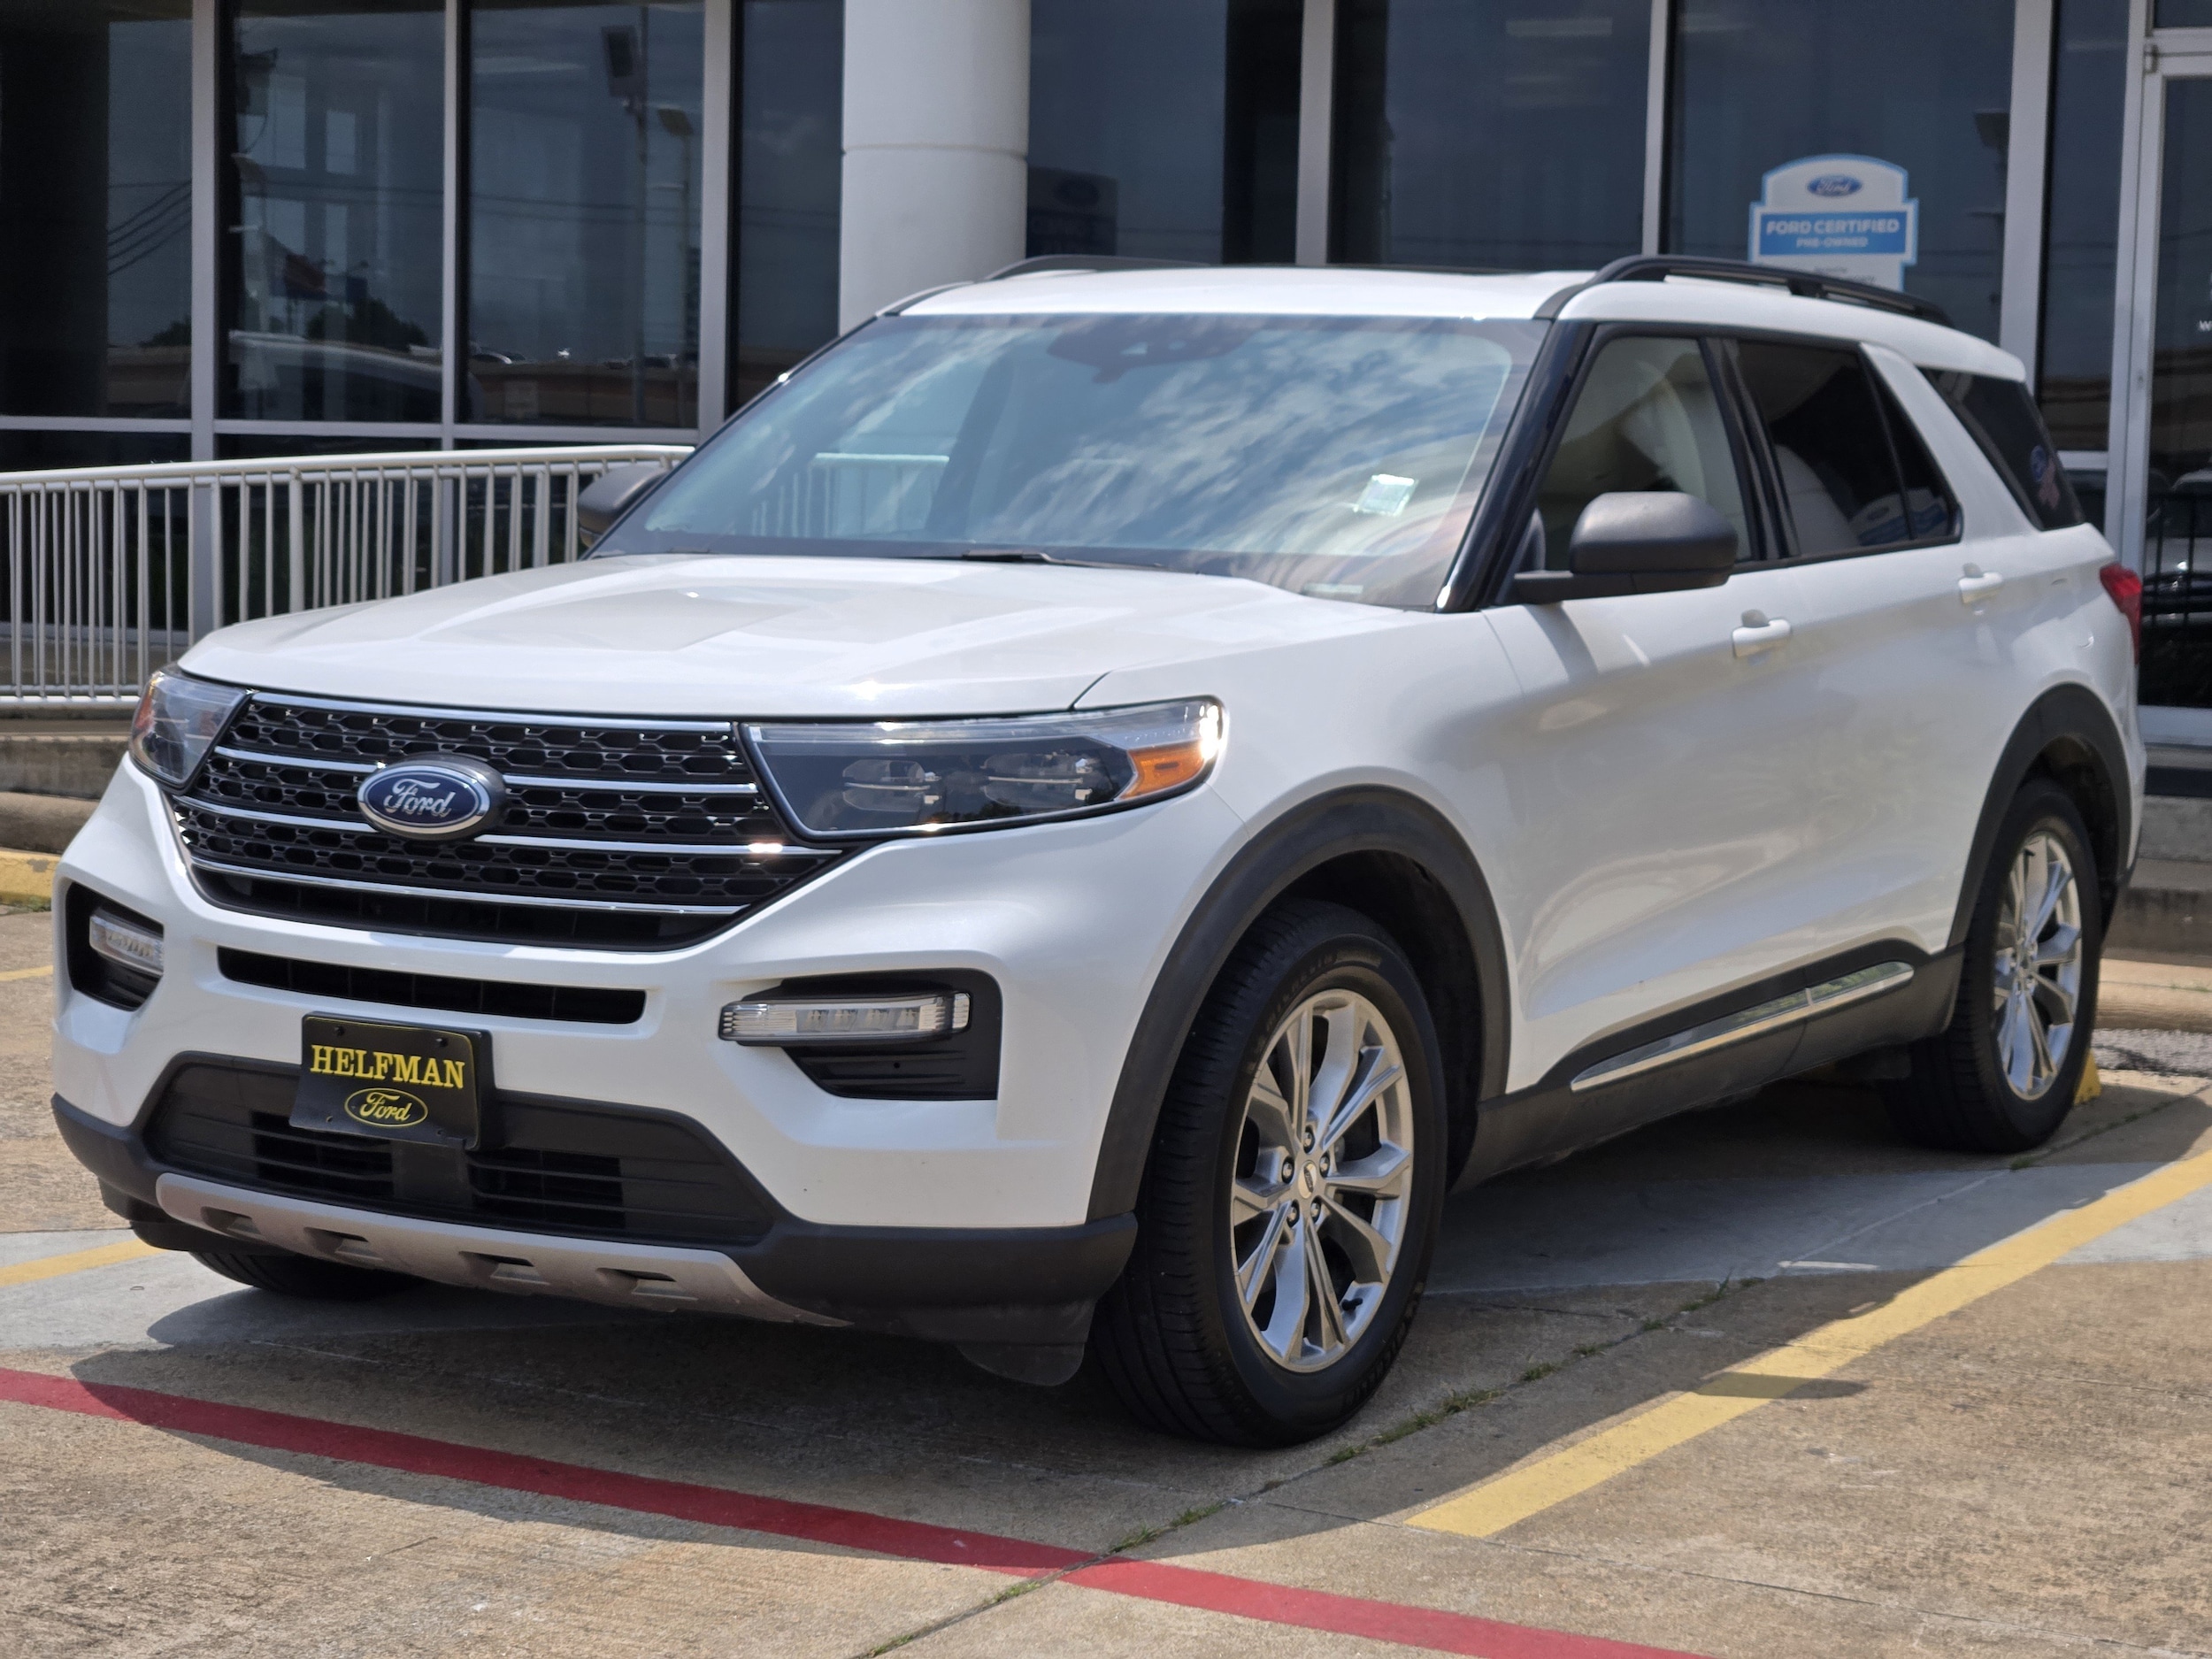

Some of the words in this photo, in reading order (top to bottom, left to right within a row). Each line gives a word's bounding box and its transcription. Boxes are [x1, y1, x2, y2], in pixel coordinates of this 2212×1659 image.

[1766, 220, 1812, 235] FORD
[1814, 219, 1901, 234] CERTIFIED
[383, 778, 457, 818] Ford
[310, 1044, 465, 1089] HELFMAN
[359, 1091, 412, 1122] Ford
